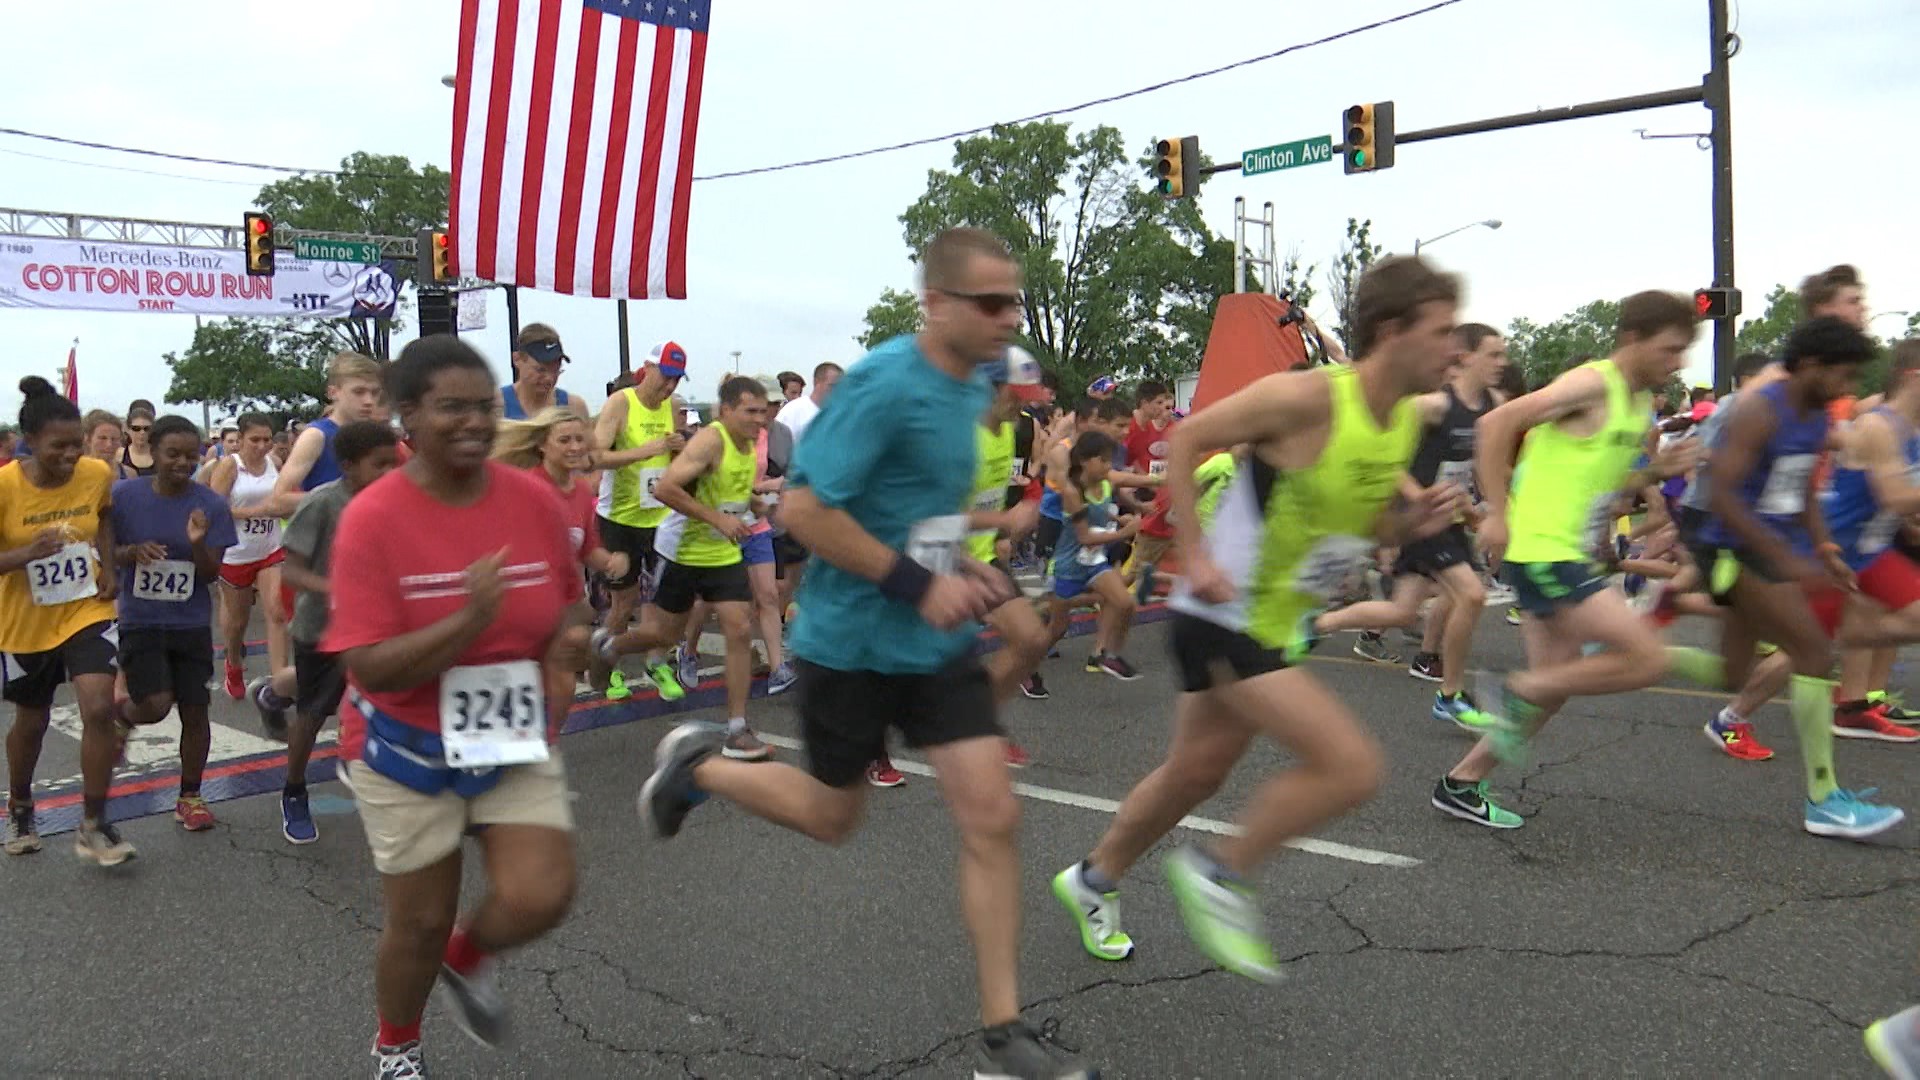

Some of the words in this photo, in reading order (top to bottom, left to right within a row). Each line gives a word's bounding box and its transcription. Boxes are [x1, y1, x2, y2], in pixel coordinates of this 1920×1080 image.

[1245, 150, 1294, 173] Clinton
[1302, 143, 1329, 161] Ave
[79, 244, 224, 270] Mercedes-Benz
[297, 241, 354, 260] Monroe
[361, 245, 377, 261] St
[22, 263, 140, 297] COTTON
[146, 269, 215, 299] ROW
[221, 273, 273, 300] RUN
[138, 300, 175, 311] START
[243, 517, 274, 535] 3250
[34, 556, 89, 587] 3243
[139, 571, 189, 594] 3242
[452, 684, 537, 732] 3245
